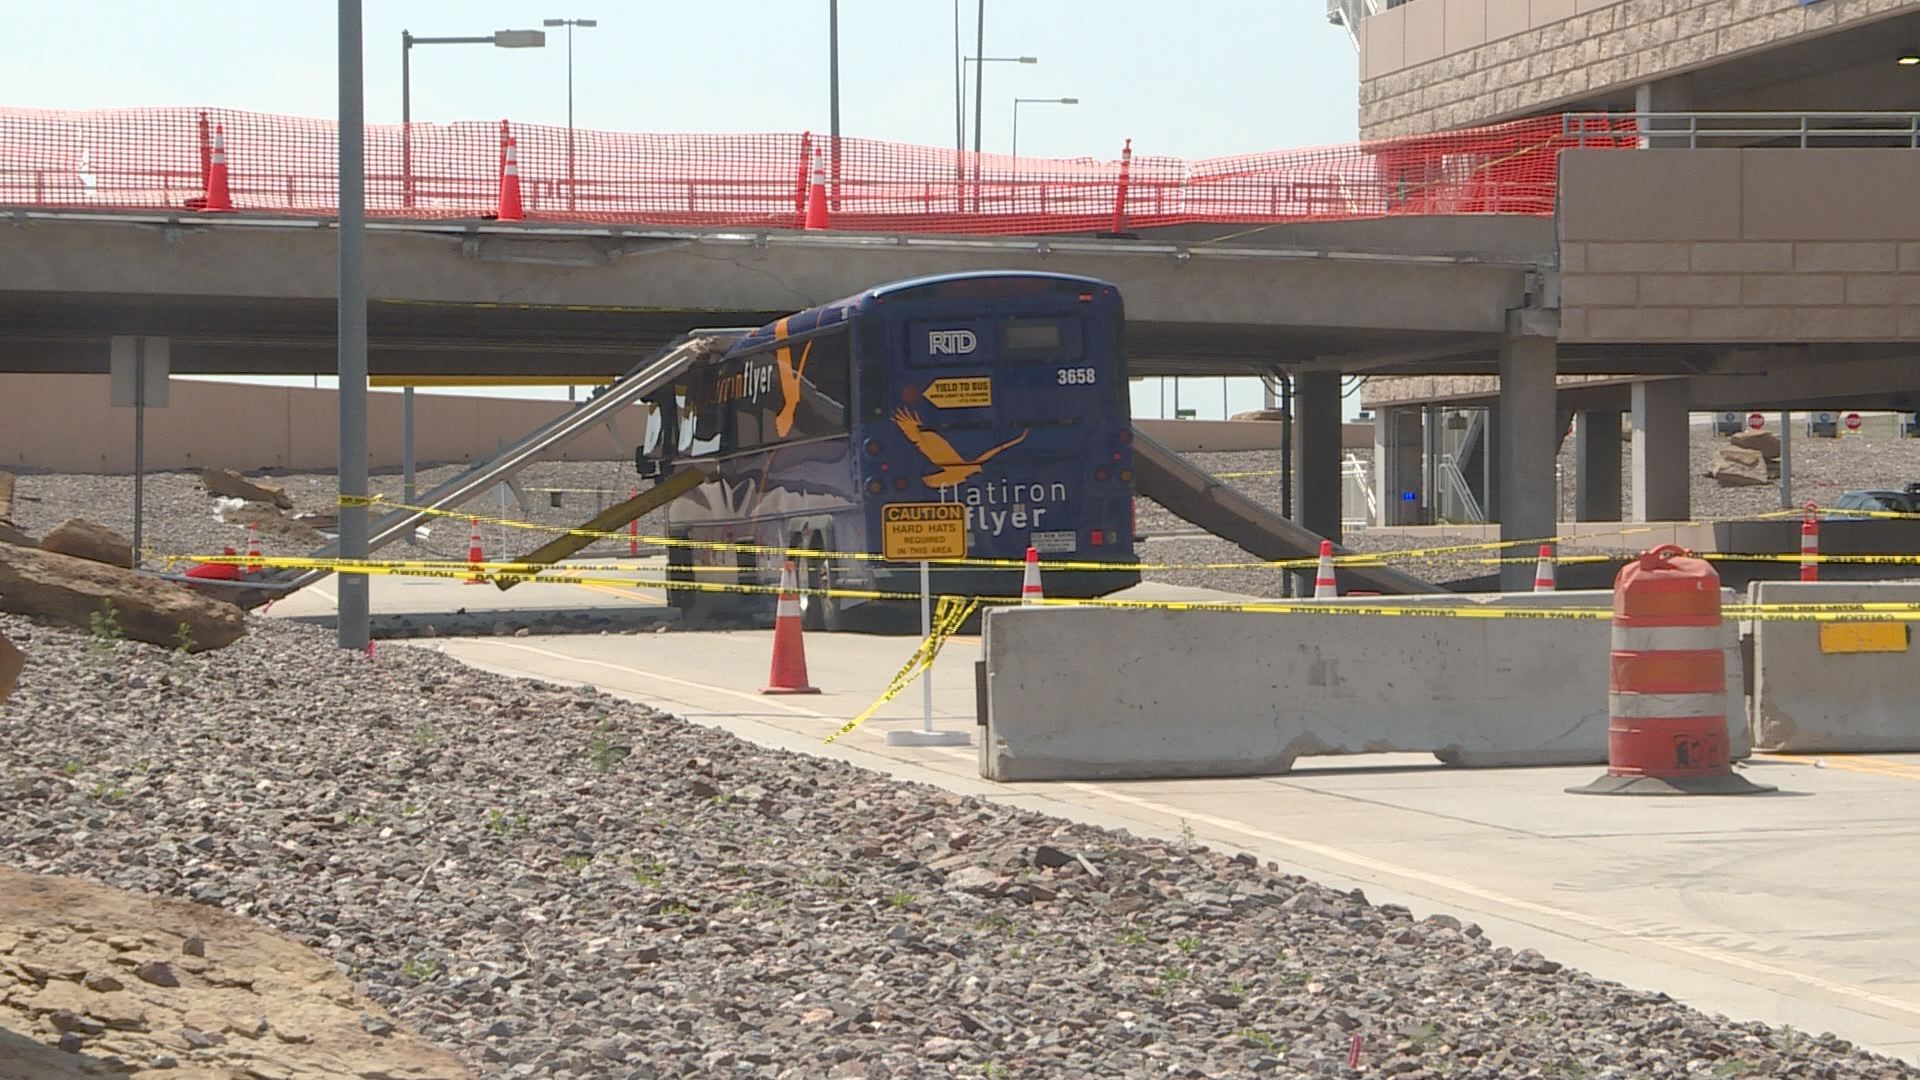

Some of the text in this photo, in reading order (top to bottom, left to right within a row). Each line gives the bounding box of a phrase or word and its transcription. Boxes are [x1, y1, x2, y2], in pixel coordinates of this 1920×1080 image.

[929, 329, 977, 354] RTD
[1057, 368, 1096, 385] 3658
[935, 381, 988, 392] YIELD TO BUS
[938, 478, 1066, 506] flatiron
[888, 506, 960, 521] CAUTION
[966, 505, 1047, 537] flyer
[892, 523, 956, 534] HARD HATS
[903, 535, 946, 544] REQUIRED
[931, 546, 953, 554] AREA
